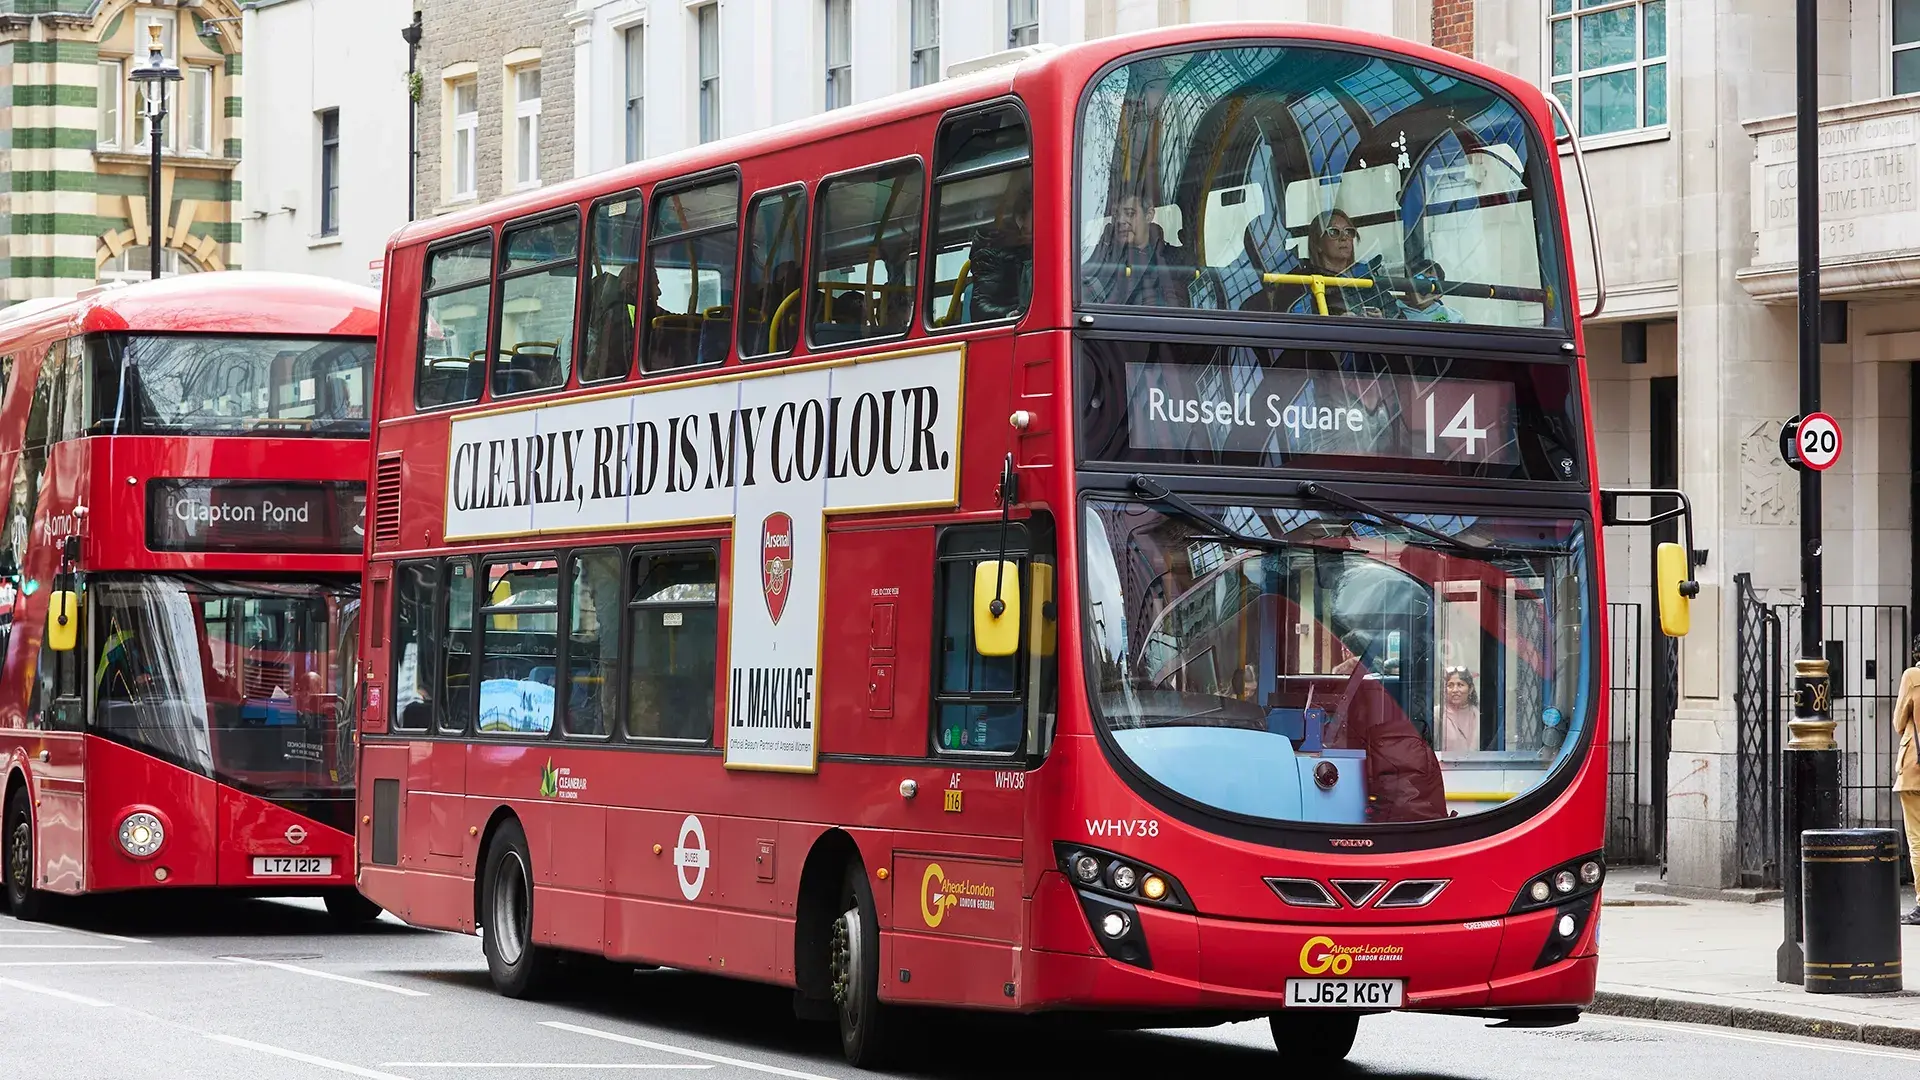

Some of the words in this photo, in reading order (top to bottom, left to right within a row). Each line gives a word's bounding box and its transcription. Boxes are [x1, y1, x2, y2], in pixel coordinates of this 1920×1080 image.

[1771, 136, 1797, 154] LOND
[1819, 126, 1860, 146] COUNTY
[1865, 119, 1911, 139] COUNCIL
[1777, 162, 1839, 190] COGE
[1842, 158, 1872, 181] FOR
[1874, 153, 1905, 177] THE
[1770, 188, 1857, 219] DISTUTIVE
[1860, 181, 1912, 209] TRADES
[1823, 222, 1855, 244] 1938
[1149, 387, 1256, 427] Russell
[1266, 393, 1364, 439] Square
[1425, 391, 1487, 455] 14
[453, 429, 585, 513] CLEARLY,
[590, 421, 659, 499] RED
[664, 414, 698, 493] IS
[704, 406, 767, 489] MY
[770, 385, 949, 484] COLOUR.
[1804, 430, 1836, 453] 20
[175, 498, 255, 527] Clapton
[262, 500, 309, 523] Pond
[765, 530, 790, 548] Arsenal
[731, 667, 744, 728] IL
[747, 667, 813, 730] MAKIAGE
[730, 738, 744, 750] Official
[745, 739, 758, 752] Beauty
[759, 739, 775, 751] Partner
[775, 740, 780, 751] of
[780, 741, 794, 752] Arsenal
[795, 741, 811, 752] Women
[949, 772, 961, 789] AF
[995, 771, 1025, 790] WHV38
[946, 793, 960, 810] 116
[1085, 818, 1159, 838] WHV38
[1329, 838, 1375, 848] VOLVO
[264, 859, 291, 873] LTZ
[295, 859, 321, 873] 1212
[685, 852, 698, 863] BUSES
[941, 879, 995, 898] Ahead-London
[959, 897, 976, 909] LONDON
[977, 899, 995, 911] GENERAL
[1329, 943, 1404, 955] Ahead-London
[1354, 954, 1378, 962] LONDON
[1379, 954, 1403, 962] GENERAL
[1294, 981, 1349, 1004] LJ62
[1353, 981, 1394, 1004] KGY
